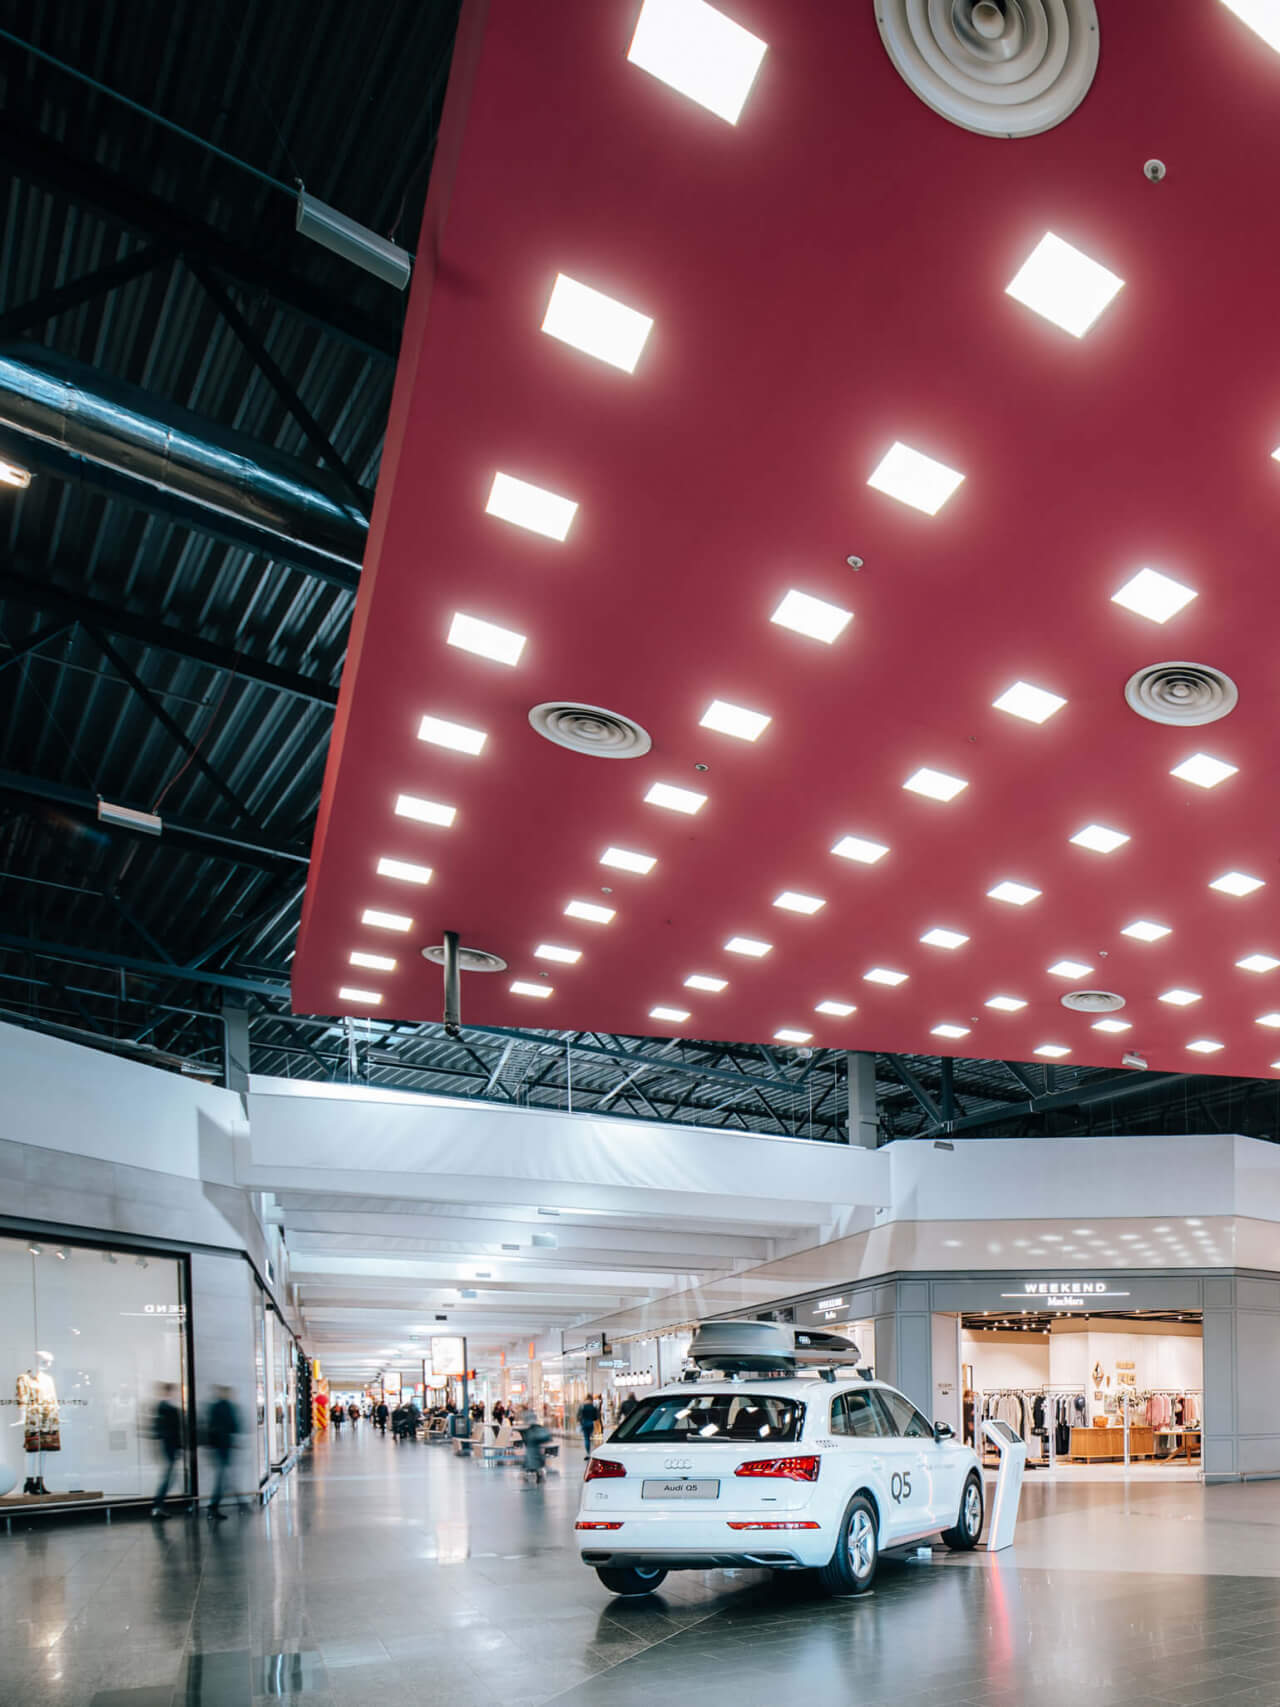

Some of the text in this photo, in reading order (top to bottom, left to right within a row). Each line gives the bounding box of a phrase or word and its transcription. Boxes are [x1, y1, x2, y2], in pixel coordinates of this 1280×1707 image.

[1024, 1283, 1106, 1293] WEEKEND
[663, 1484, 698, 1492] Audi Q5
[891, 1471, 912, 1505] Q5
